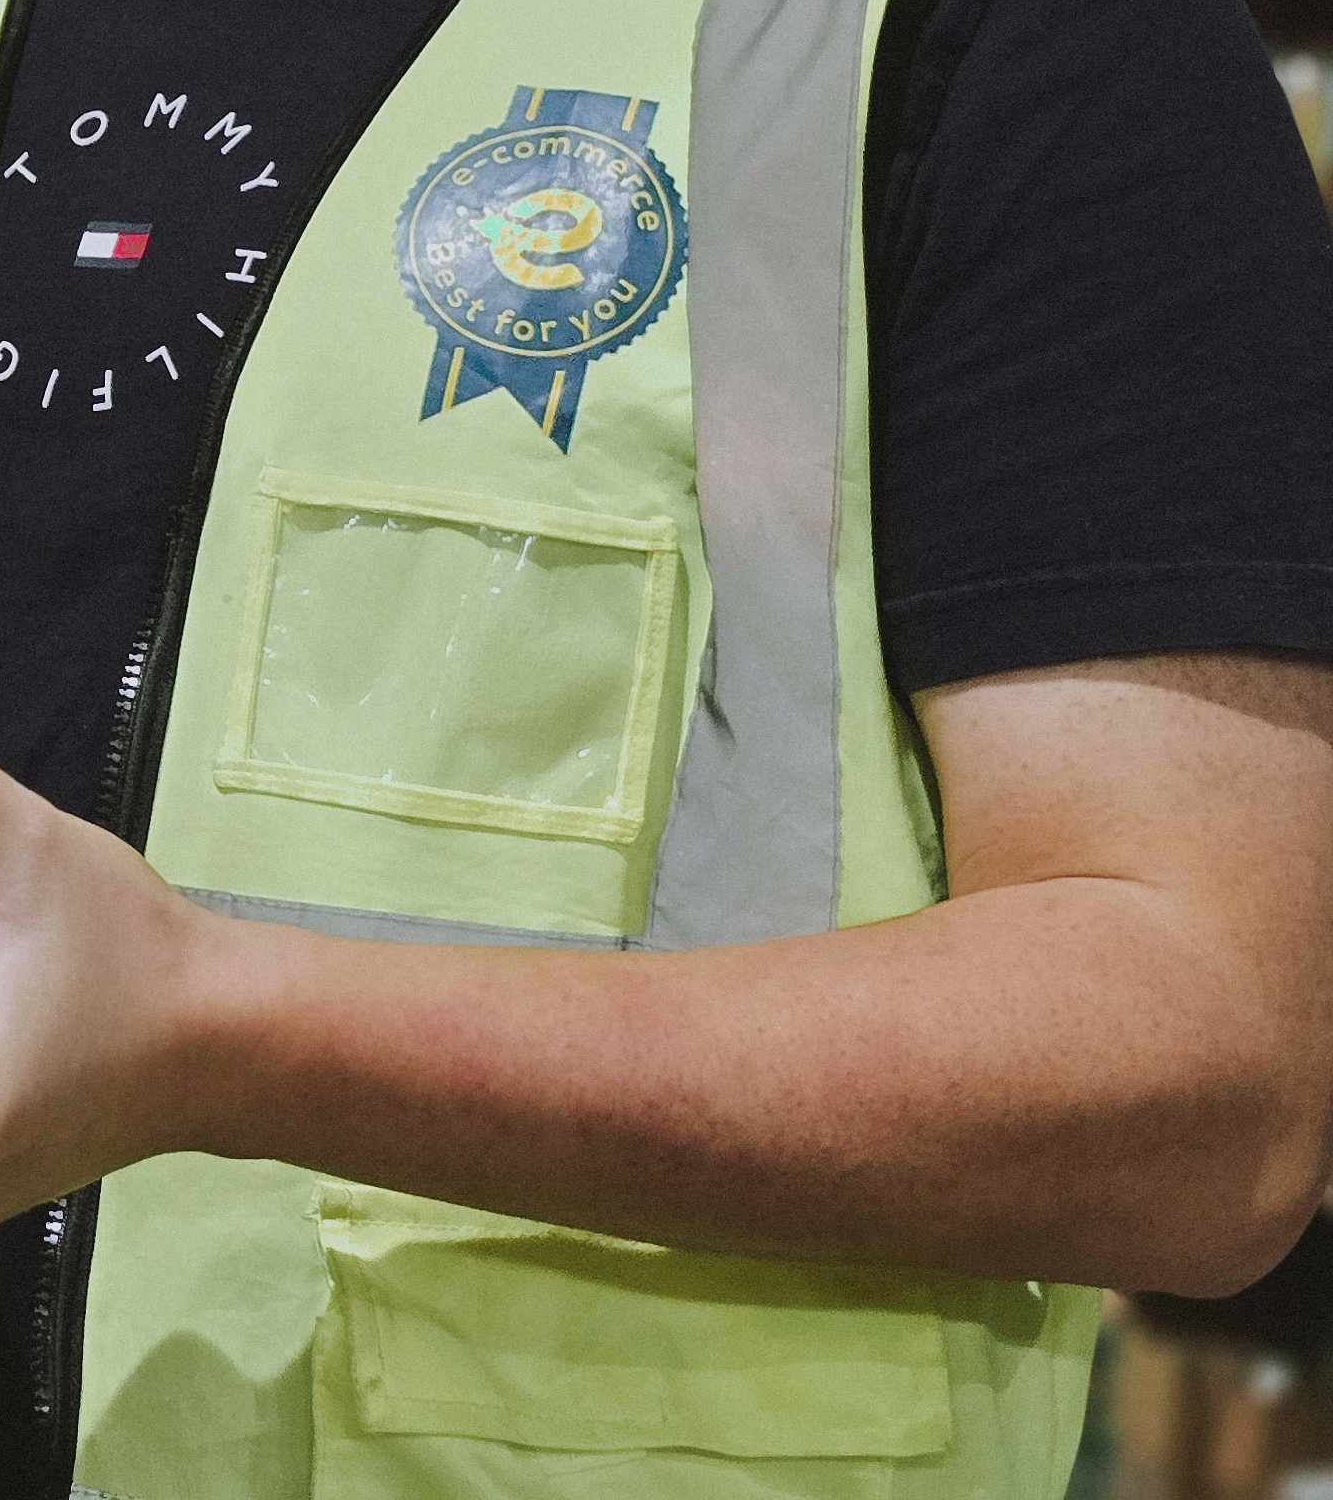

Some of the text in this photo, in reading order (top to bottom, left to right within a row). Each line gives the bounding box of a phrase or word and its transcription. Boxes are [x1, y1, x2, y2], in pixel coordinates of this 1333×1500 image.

[3, 92, 280, 193] TOMMY
[451, 135, 661, 232] e-commerce
[425, 241, 639, 343] Best for you
